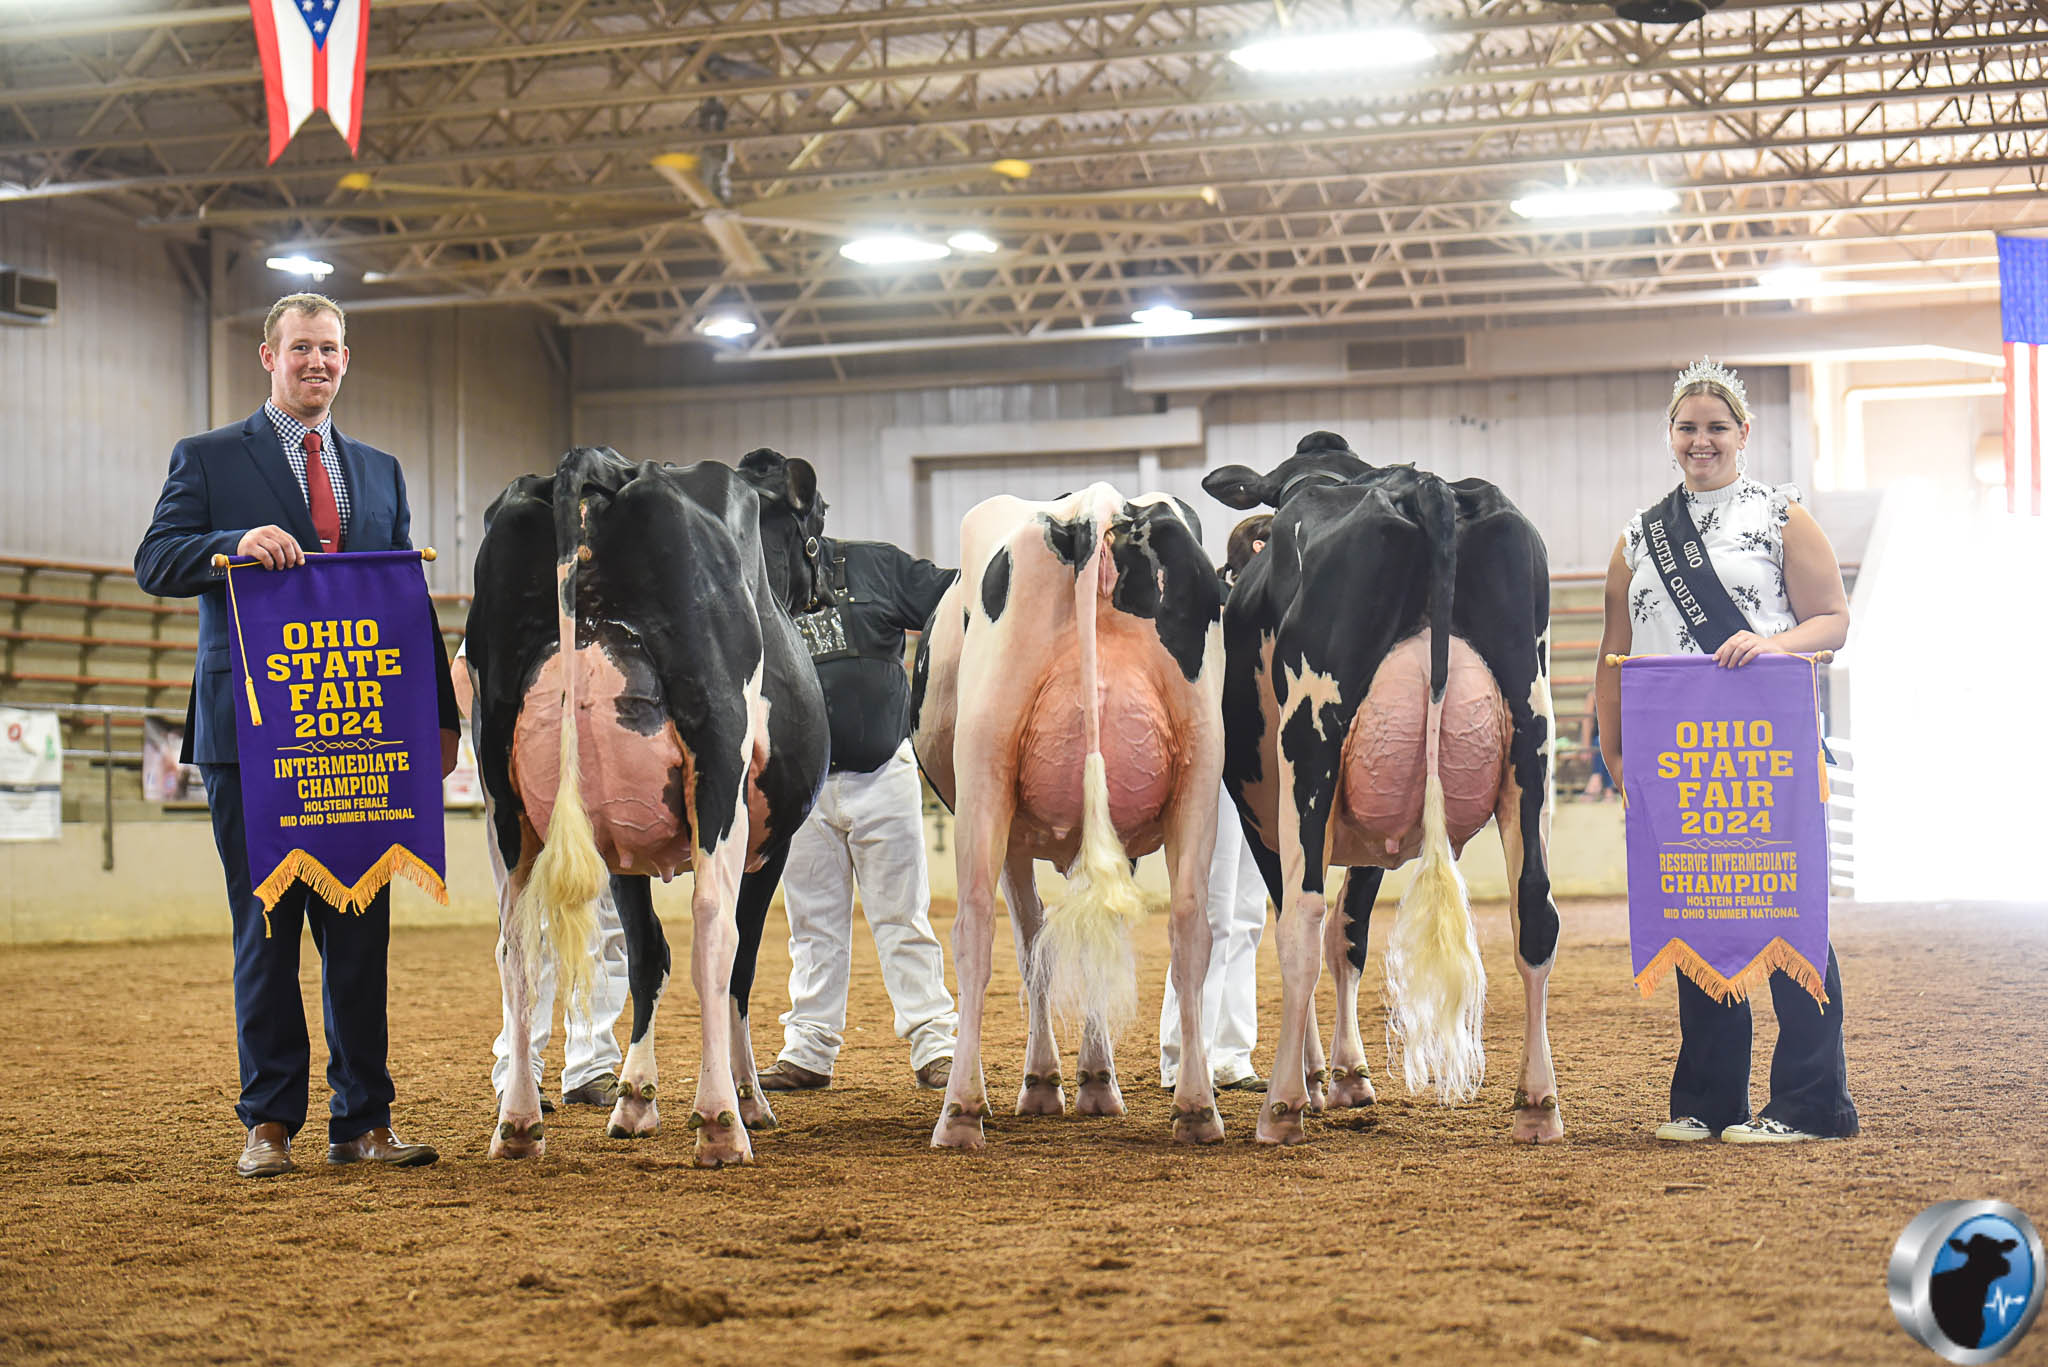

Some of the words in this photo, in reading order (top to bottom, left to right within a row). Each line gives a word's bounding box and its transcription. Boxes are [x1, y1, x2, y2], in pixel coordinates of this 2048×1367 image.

[1683, 540, 1704, 569] OHIO
[1649, 519, 1679, 575] HOLSTEIN
[1670, 576, 1709, 626] QUEEN
[283, 619, 379, 650] OHIO
[266, 648, 401, 682] STATE
[289, 680, 383, 711] FAIR
[295, 710, 383, 738] 2024
[1676, 719, 1774, 749] OHIO
[274, 752, 410, 778] INTERMEDIATE
[1657, 750, 1794, 779] STATE
[297, 775, 389, 799] CHAMPION
[1678, 780, 1774, 809] FAIR
[280, 815, 298, 827] MID
[299, 813, 324, 826] OHIO
[326, 810, 366, 825] SUMMER
[367, 808, 415, 821] NATIONAL
[304, 799, 352, 812] HOLSTEIN
[353, 797, 388, 809] FEMALE
[1681, 810, 1772, 835] 2024
[1659, 852, 1708, 872] RESERVE
[1711, 851, 1797, 872] INTERMEDIATE
[1661, 873, 1797, 893] CHAMPION
[1663, 908, 1680, 919] MID
[1681, 908, 1705, 919] OHIO
[1707, 908, 1748, 919] SUMMER
[1750, 907, 1800, 919] NATIONAL
[1687, 895, 1733, 907] HOLSTEIN
[1735, 895, 1773, 906] FEMALE
